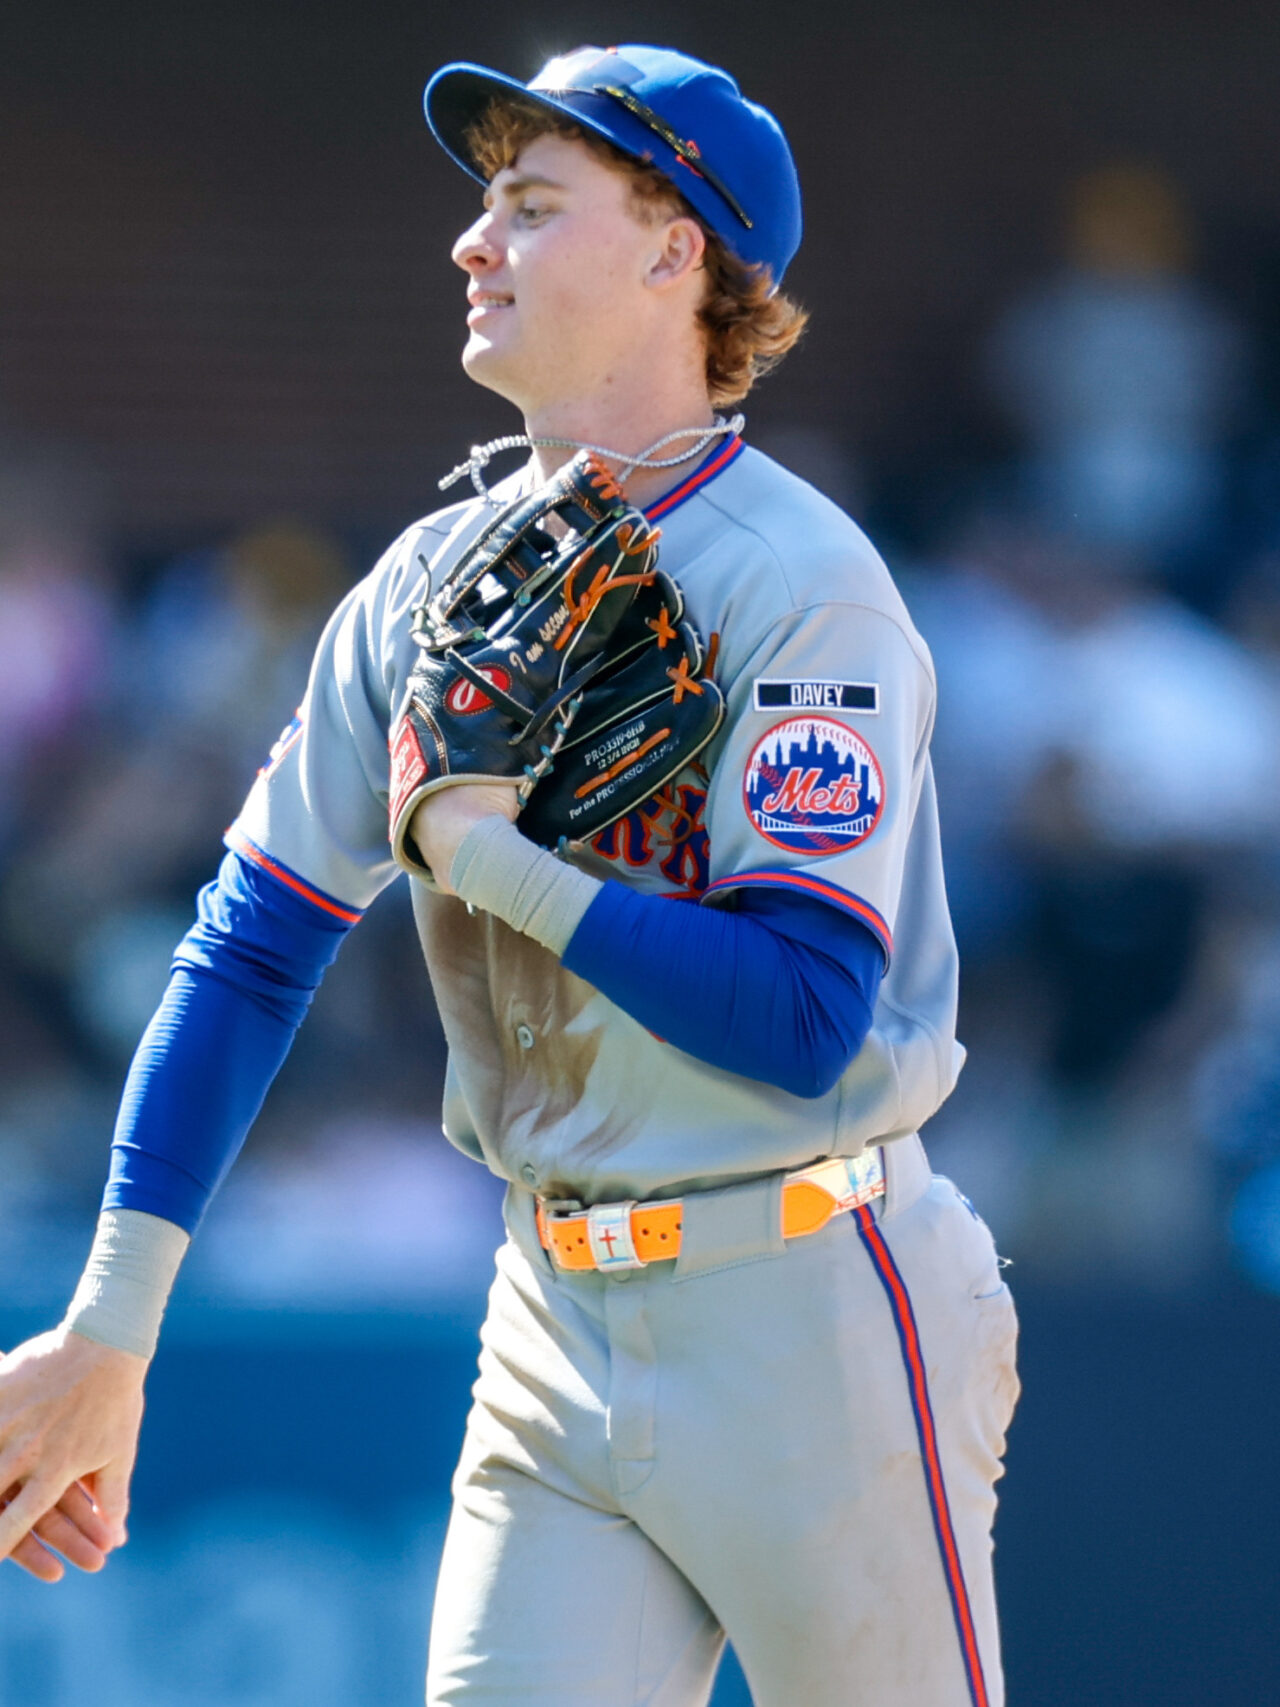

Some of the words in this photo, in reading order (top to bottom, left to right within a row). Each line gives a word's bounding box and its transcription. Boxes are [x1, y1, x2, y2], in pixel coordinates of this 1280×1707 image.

[526, 642, 544, 663] am
[791, 684, 844, 706] DAVEY
[621, 737, 641, 755] INCH
[762, 767, 862, 815] Mets
[569, 806, 583, 820] For
[583, 798, 596, 811] the
